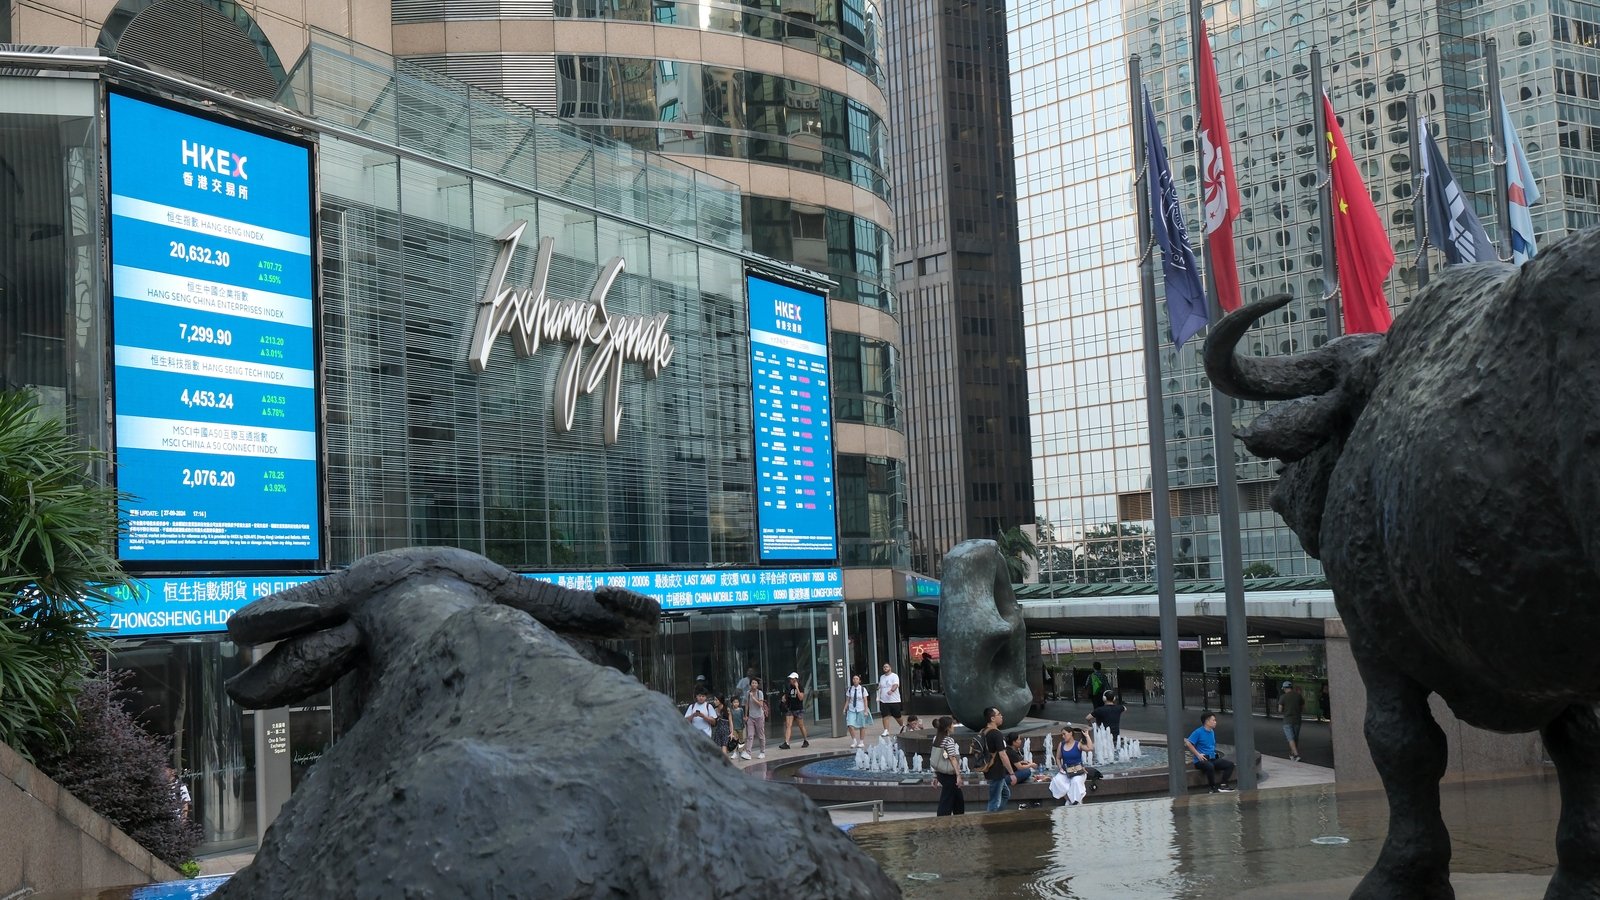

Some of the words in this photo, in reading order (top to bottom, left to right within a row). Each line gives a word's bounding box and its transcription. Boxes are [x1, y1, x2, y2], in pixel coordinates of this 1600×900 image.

[182, 140, 248, 180] HKEX
[183, 172, 248, 200] 香港交易所
[167, 211, 199, 227] 恒生指數
[201, 220, 222, 232] HANG
[224, 225, 242, 237] SENG
[243, 229, 264, 241] INDEX
[169, 241, 230, 267] 20,632.30
[263, 260, 282, 272] 707.72
[263, 274, 281, 285] 3.55%
[187, 282, 249, 302] 恒生中國企業指數
[147, 288, 170, 300] HANG
[171, 292, 191, 304] SENG
[193, 296, 216, 308] CHINA
[217, 300, 262, 315] ENTERPRISES
[263, 308, 284, 318] INDEX
[179, 323, 232, 346] 7,299.90
[265, 336, 284, 346] 213.20
[469, 219, 600, 432] Exchange
[580, 256, 674, 445] Square
[265, 349, 283, 359] 3.01%
[151, 354, 200, 371] 恒生科技指數
[202, 362, 224, 373] HANG
[225, 365, 243, 376] SENG
[244, 368, 262, 378] TECH
[263, 370, 284, 381] INDEX
[181, 388, 234, 409] 4,453.24
[266, 395, 286, 405] 243.53
[162, 438, 181, 448] MSCI
[182, 439, 205, 449] CHINA
[206, 441, 212, 449] A
[213, 441, 222, 450] 50
[223, 442, 256, 453] CONNECT
[257, 445, 278, 455] INDEX
[182, 468, 236, 488] 2,076.20
[268, 471, 285, 479] 78.25
[268, 484, 287, 493] 3.92%
[684, 574, 699, 585] LAST
[740, 573, 751, 584] VOL
[163, 580, 248, 602] 恒生指數期貨
[253, 581, 271, 597] HSI
[694, 591, 713, 604] CHINA
[713, 590, 733, 603] MOBILE
[811, 586, 833, 598] LONGFOR
[110, 609, 202, 629] ZHONGSHENG
